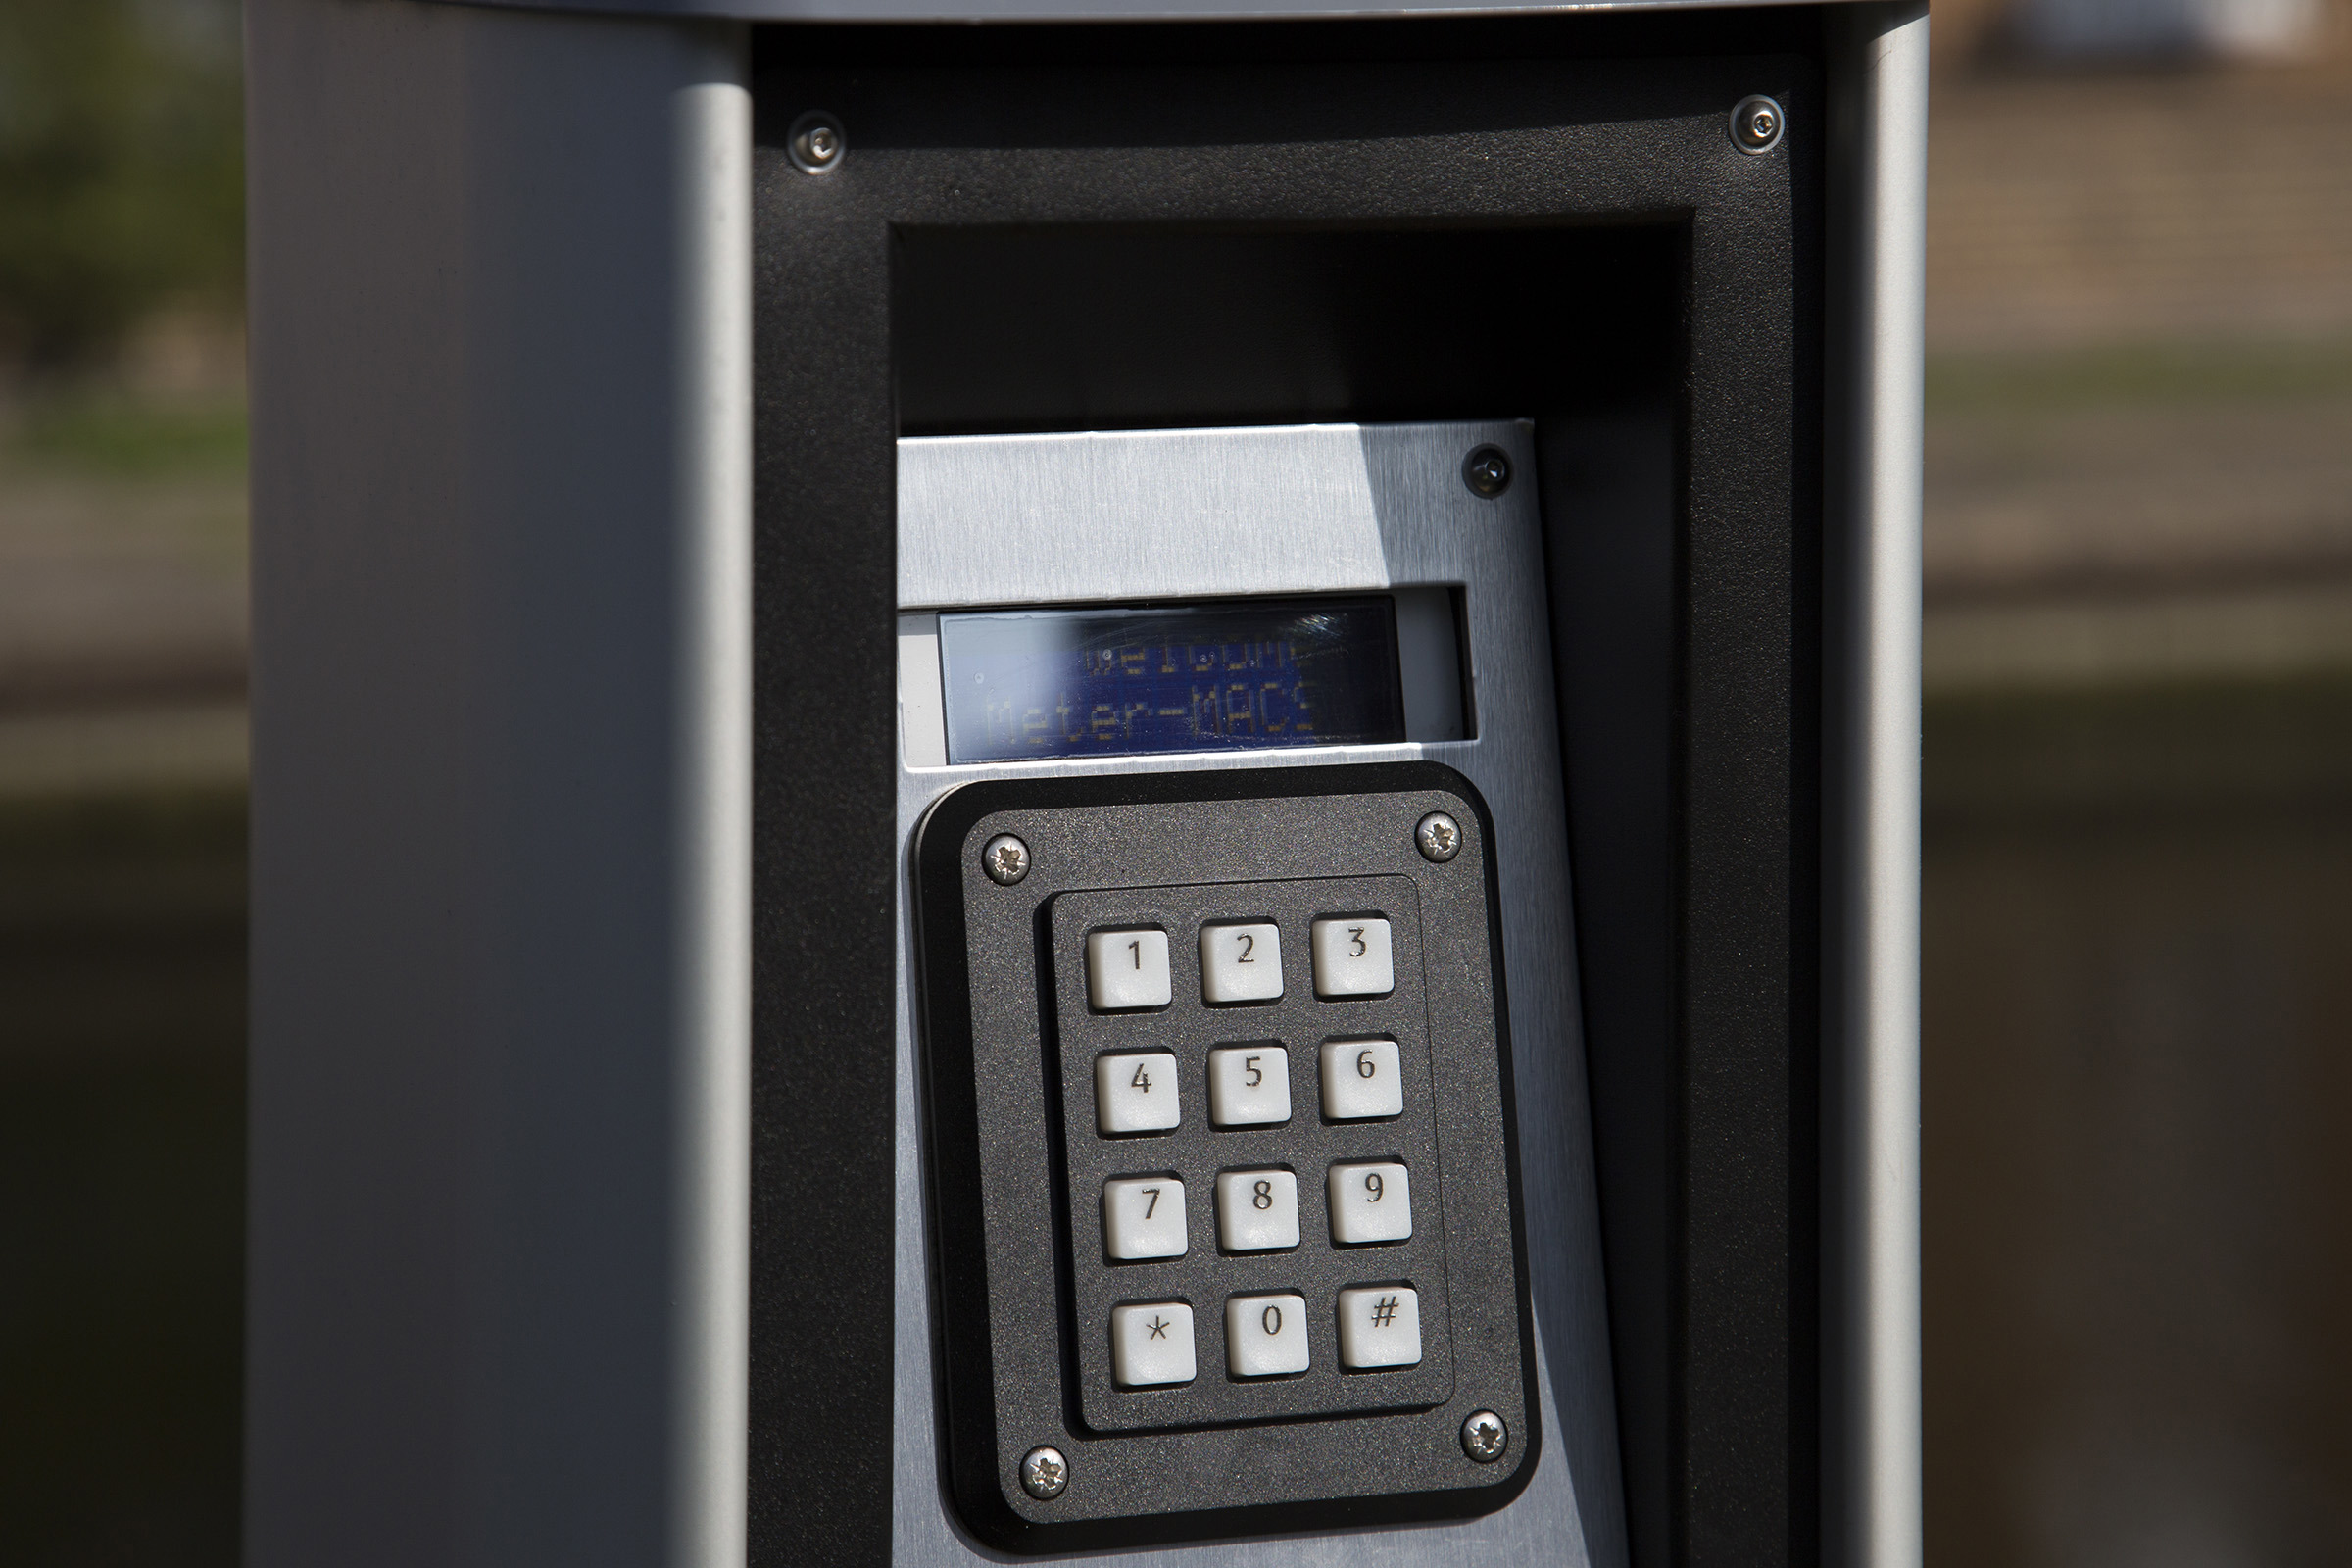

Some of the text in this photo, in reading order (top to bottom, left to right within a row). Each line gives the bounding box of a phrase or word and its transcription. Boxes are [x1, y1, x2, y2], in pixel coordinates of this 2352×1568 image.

[1128, 940, 1141, 970] 1
[1237, 933, 1255, 963] 2
[1348, 927, 1366, 957] 3
[1130, 1062, 1152, 1094] 4
[1245, 1055, 1262, 1087] 5
[1356, 1050, 1376, 1079] 6
[1252, 1179, 1273, 1210] 8
[1364, 1172, 1384, 1203] 9
[1141, 1188, 1160, 1220] 7
[1261, 1304, 1282, 1336] 0
[1370, 1296, 1399, 1328] #
